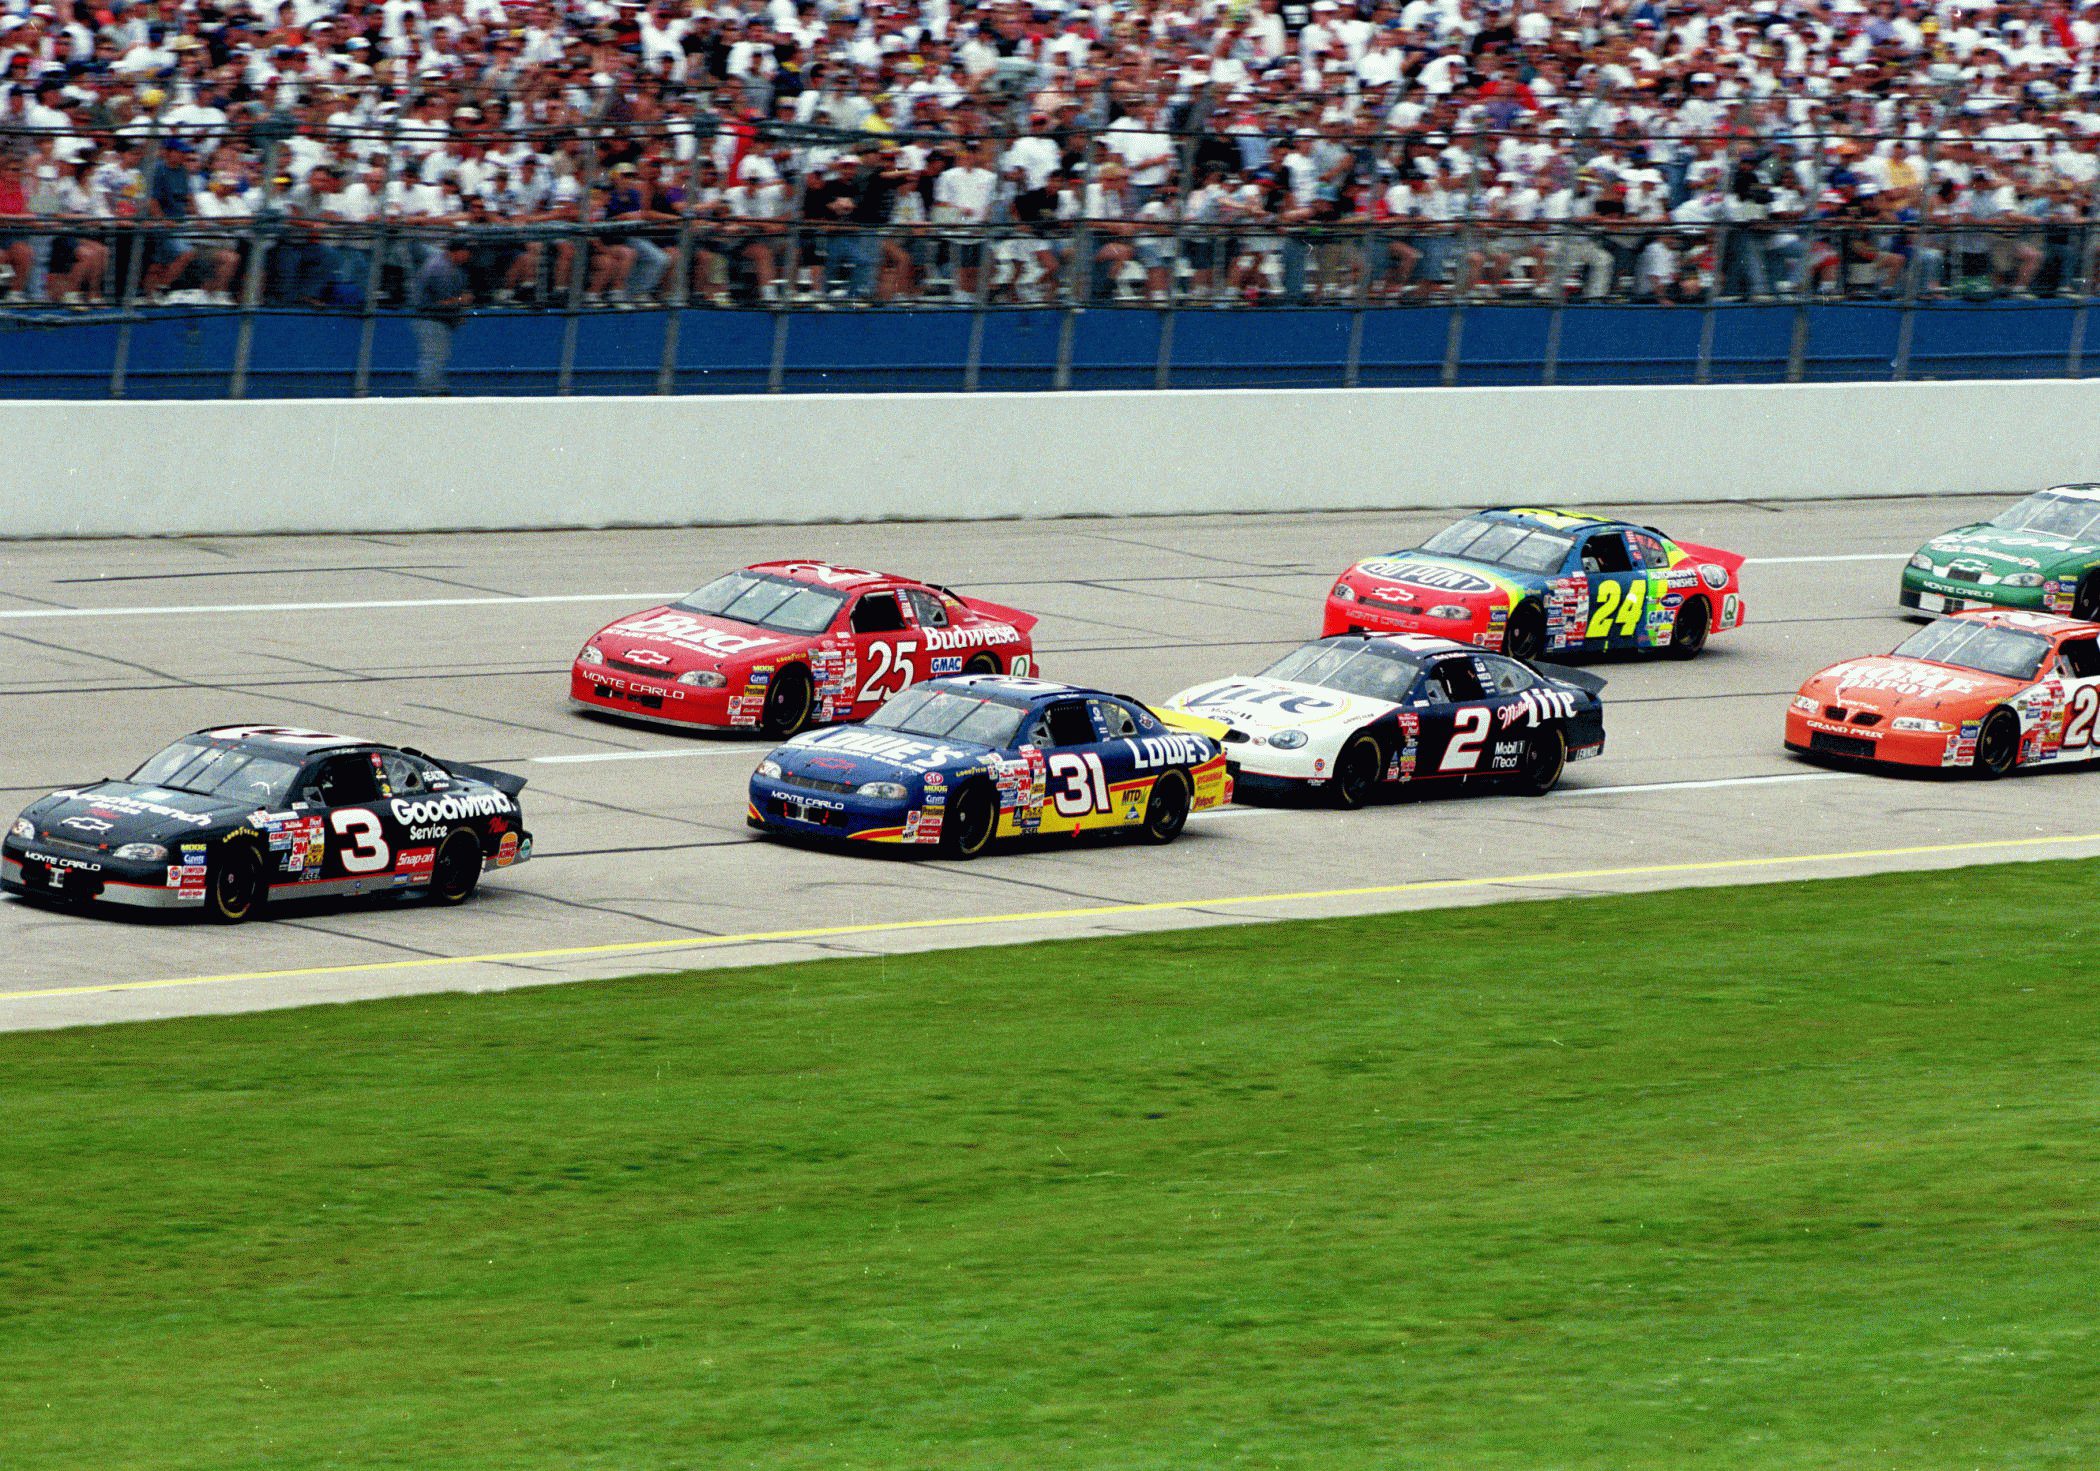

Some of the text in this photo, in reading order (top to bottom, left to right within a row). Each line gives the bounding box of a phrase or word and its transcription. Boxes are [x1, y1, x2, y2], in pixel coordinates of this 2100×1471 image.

[1924, 580, 1994, 598] MONTE CARLO
[1585, 579, 1647, 638] 24
[1649, 610, 1674, 624] GMAC
[613, 614, 782, 655] Bud
[922, 624, 1021, 651] Budweiser
[856, 640, 917, 702] 25
[932, 657, 961, 671] GMAC
[582, 670, 685, 700] MONTE CARLO
[2062, 684, 2100, 749] 2
[1438, 705, 1492, 772] 2
[1807, 720, 1884, 739] GRAND PRIX
[1495, 740, 1517, 754] Mobil
[1049, 752, 1112, 818] 31
[771, 790, 844, 810] MONTE CARLO
[1122, 789, 1142, 803] MTD
[331, 807, 390, 872] 3
[409, 823, 448, 841] Service
[293, 841, 308, 855] 3M
[396, 848, 436, 867] Snap-on
[25, 851, 101, 872] MONTE CARLO
